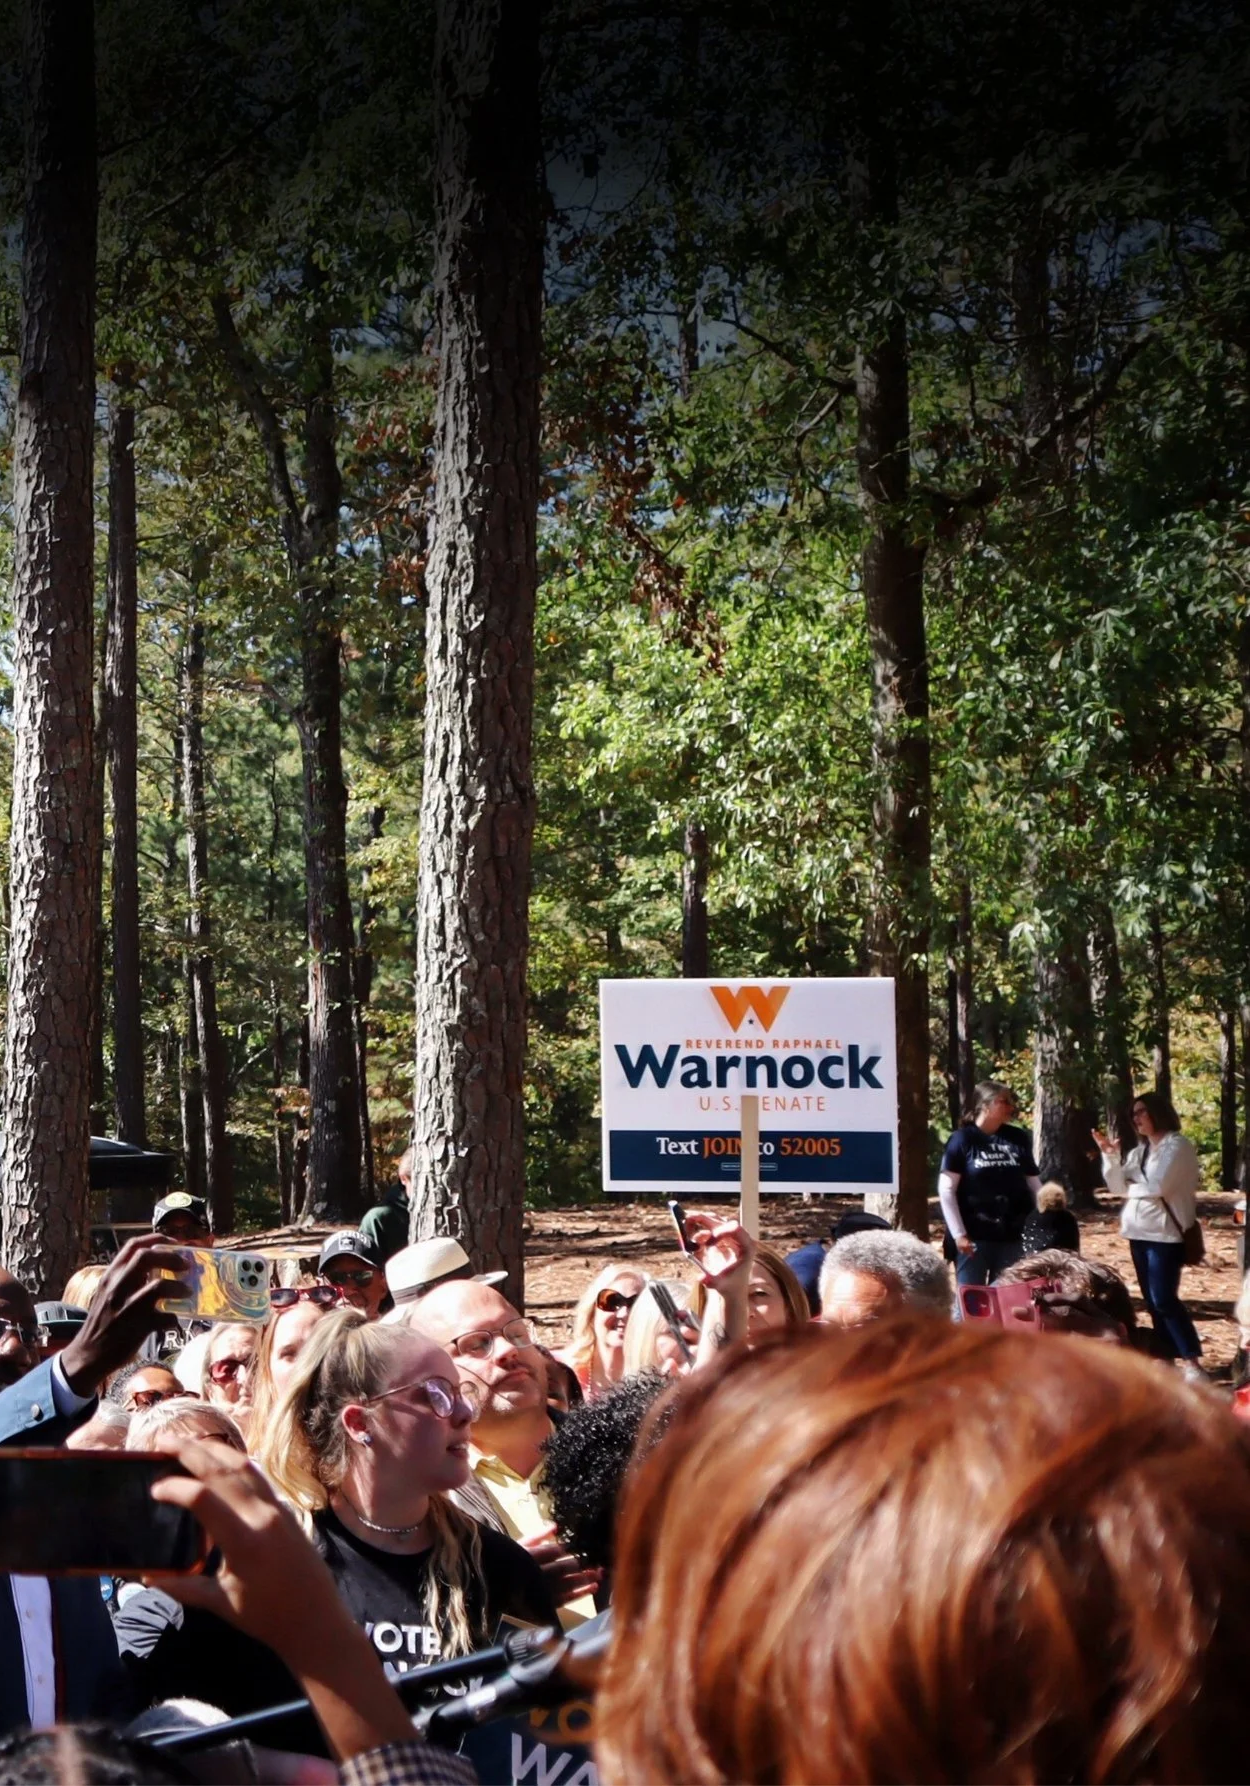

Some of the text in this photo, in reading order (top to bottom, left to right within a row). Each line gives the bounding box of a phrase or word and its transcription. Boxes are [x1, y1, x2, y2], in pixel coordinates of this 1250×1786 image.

[710, 986, 791, 1033] W
[686, 1040, 842, 1049] REVEREND RAPHAEL
[614, 1044, 884, 1089] Warnock
[700, 1096, 826, 1111] U.S. ENATE
[656, 1137, 699, 1155] Text
[780, 1138, 842, 1156] 52005
